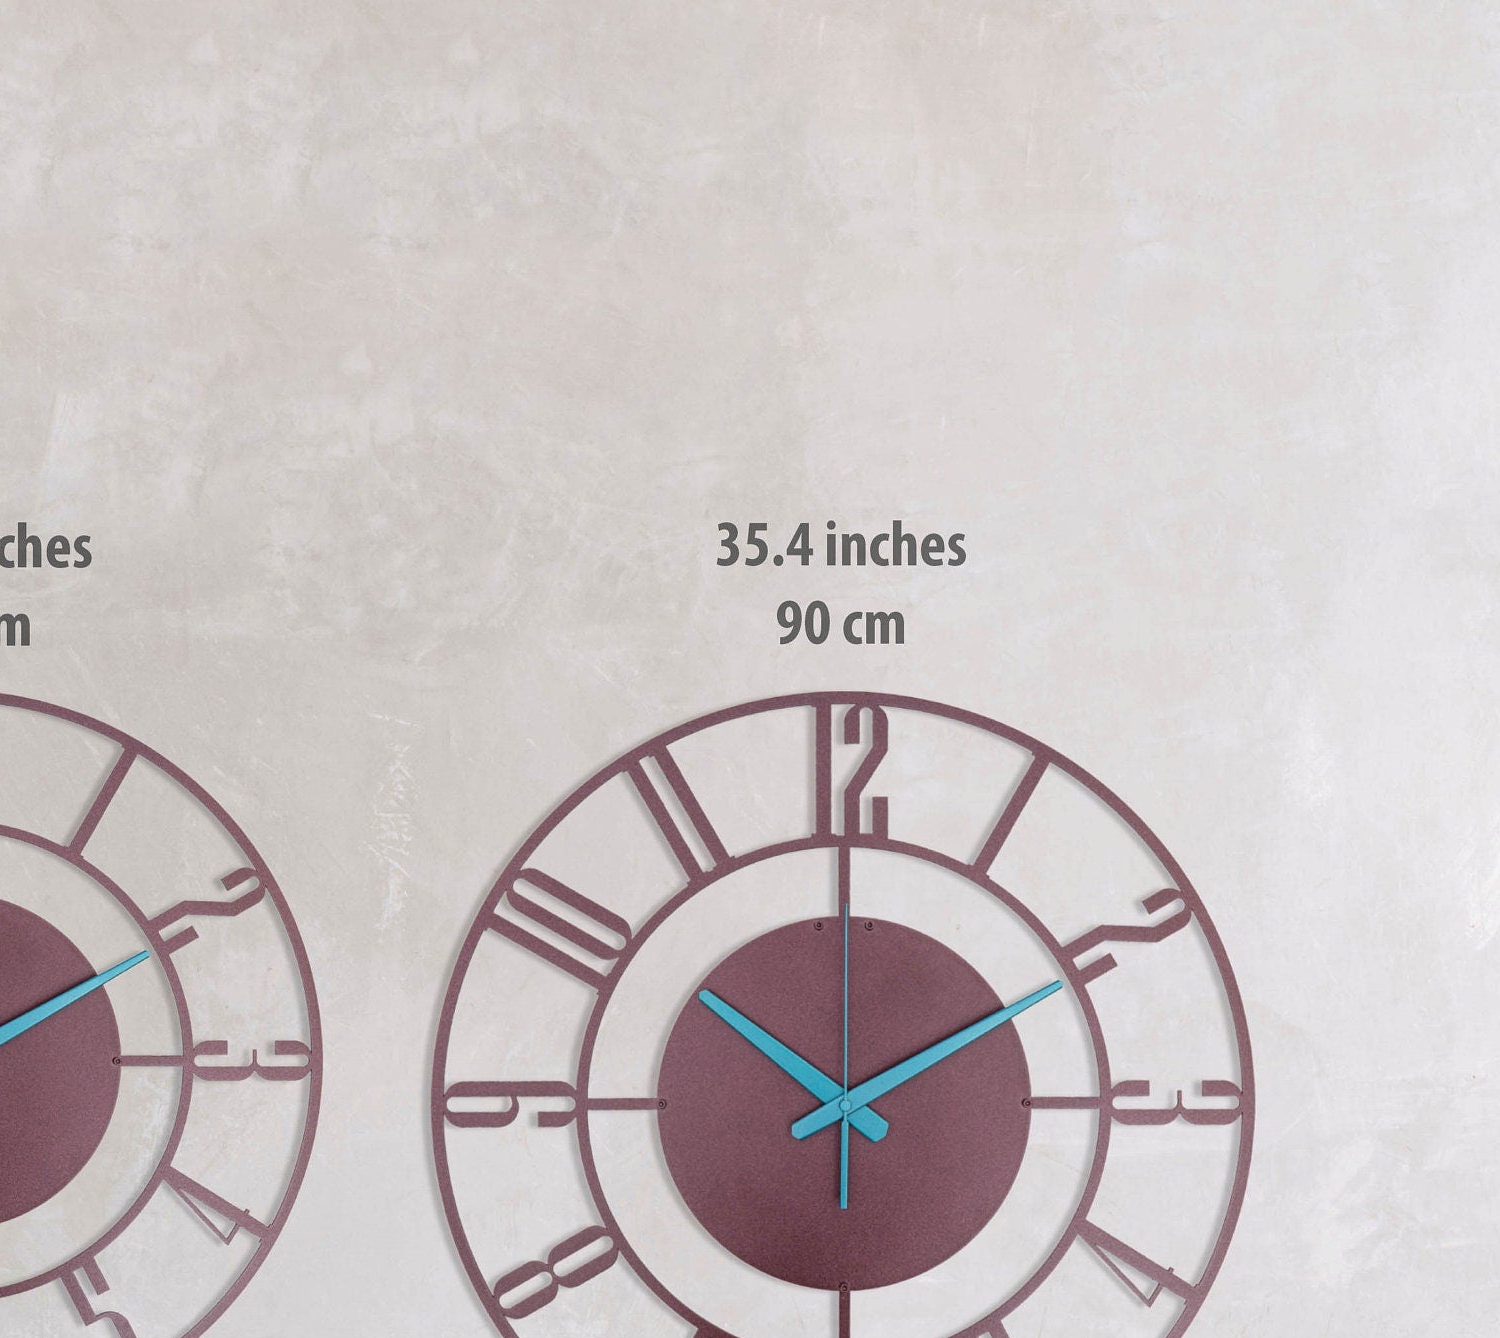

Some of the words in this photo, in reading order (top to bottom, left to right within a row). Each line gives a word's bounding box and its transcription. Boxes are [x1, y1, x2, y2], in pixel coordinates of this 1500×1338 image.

[811, 703, 889, 838] 12
[624, 753, 736, 883] 11
[150, 868, 266, 954] 2
[483, 867, 632, 992] 10
[1062, 889, 1192, 988] 2
[193, 1040, 311, 1081] 3
[442, 1080, 577, 1128] 9
[1109, 1080, 1242, 1125] 3
[165, 1166, 272, 1245] 4
[494, 1224, 619, 1319] 8
[1077, 1220, 1197, 1307] 4
